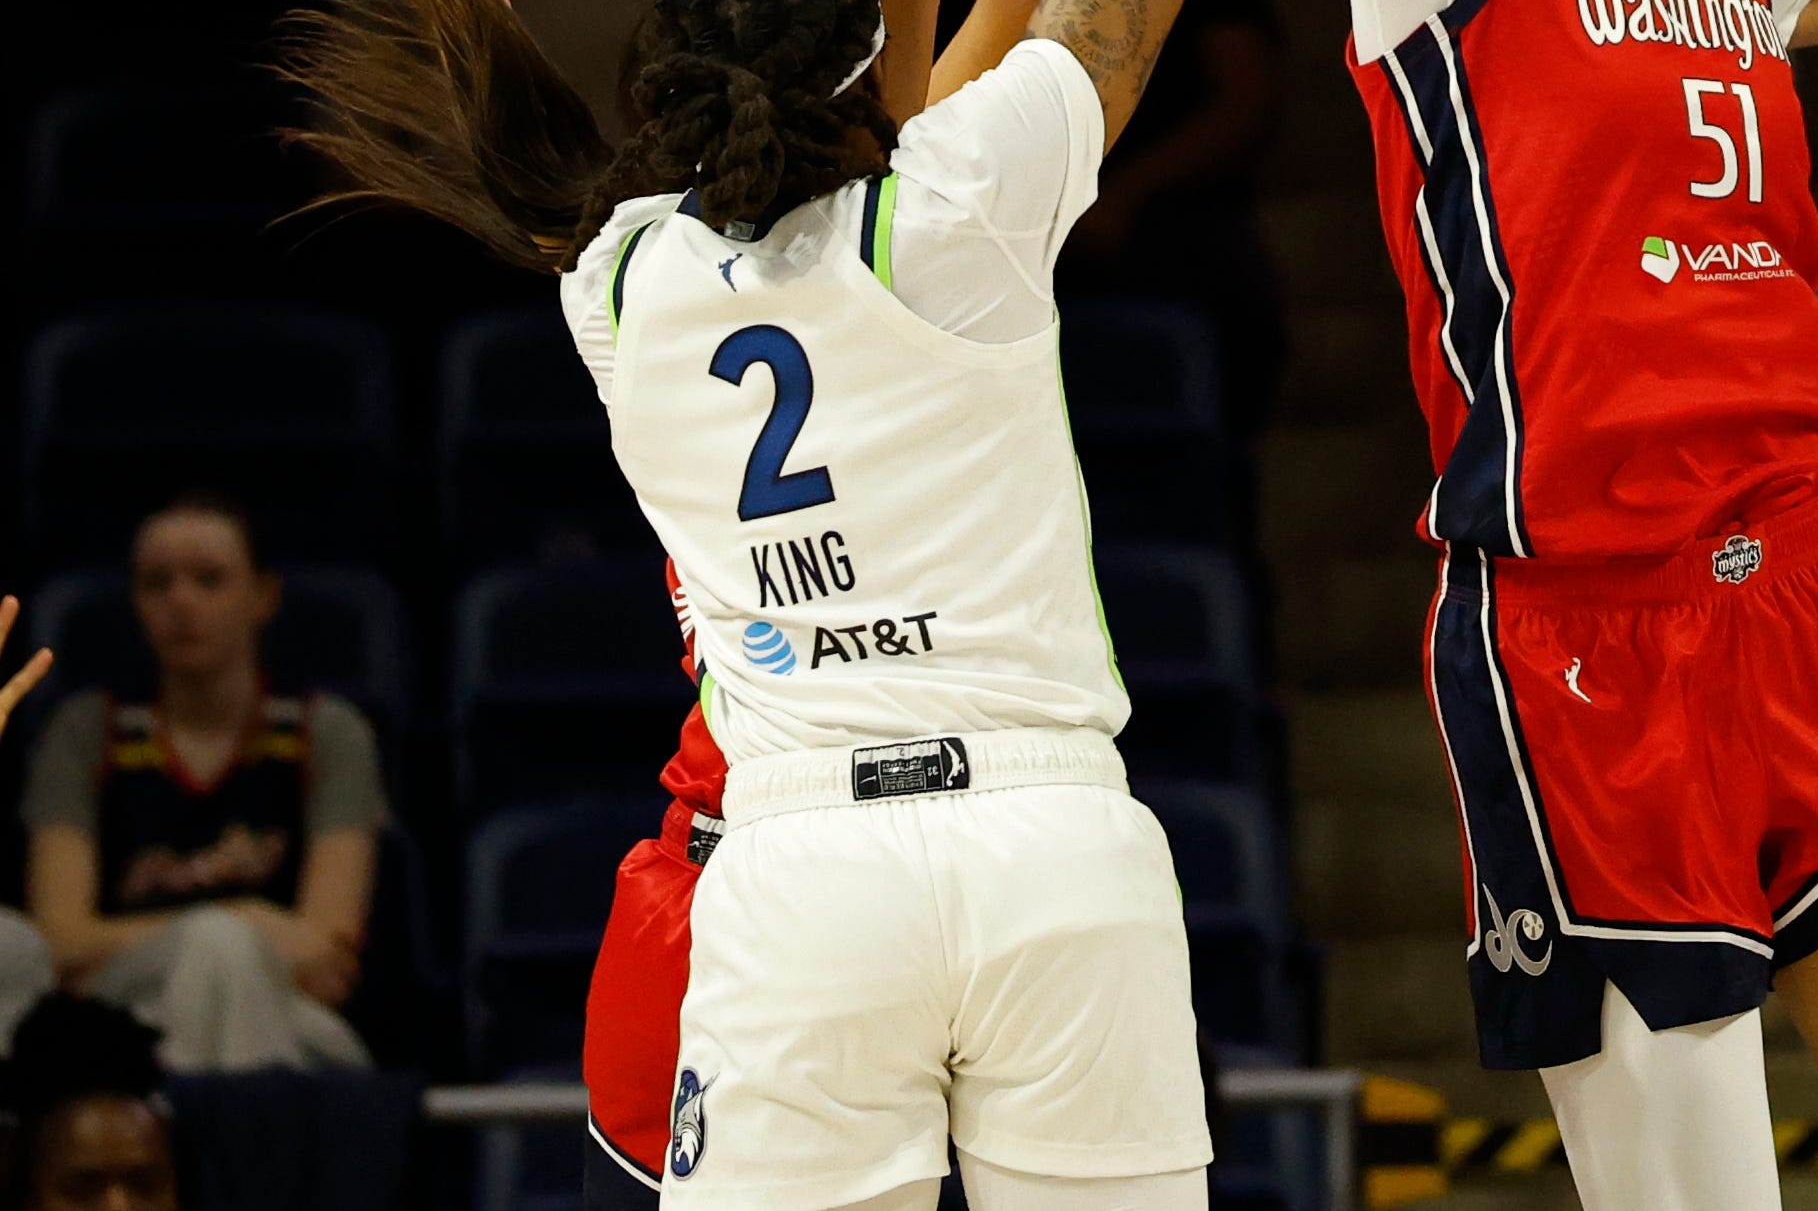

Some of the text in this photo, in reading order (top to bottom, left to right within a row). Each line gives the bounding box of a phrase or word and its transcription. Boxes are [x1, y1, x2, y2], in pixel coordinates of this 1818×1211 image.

[1681, 76, 1763, 204] 51
[708, 323, 836, 522] 2
[750, 530, 856, 608] KING
[811, 611, 938, 670] AT&T
